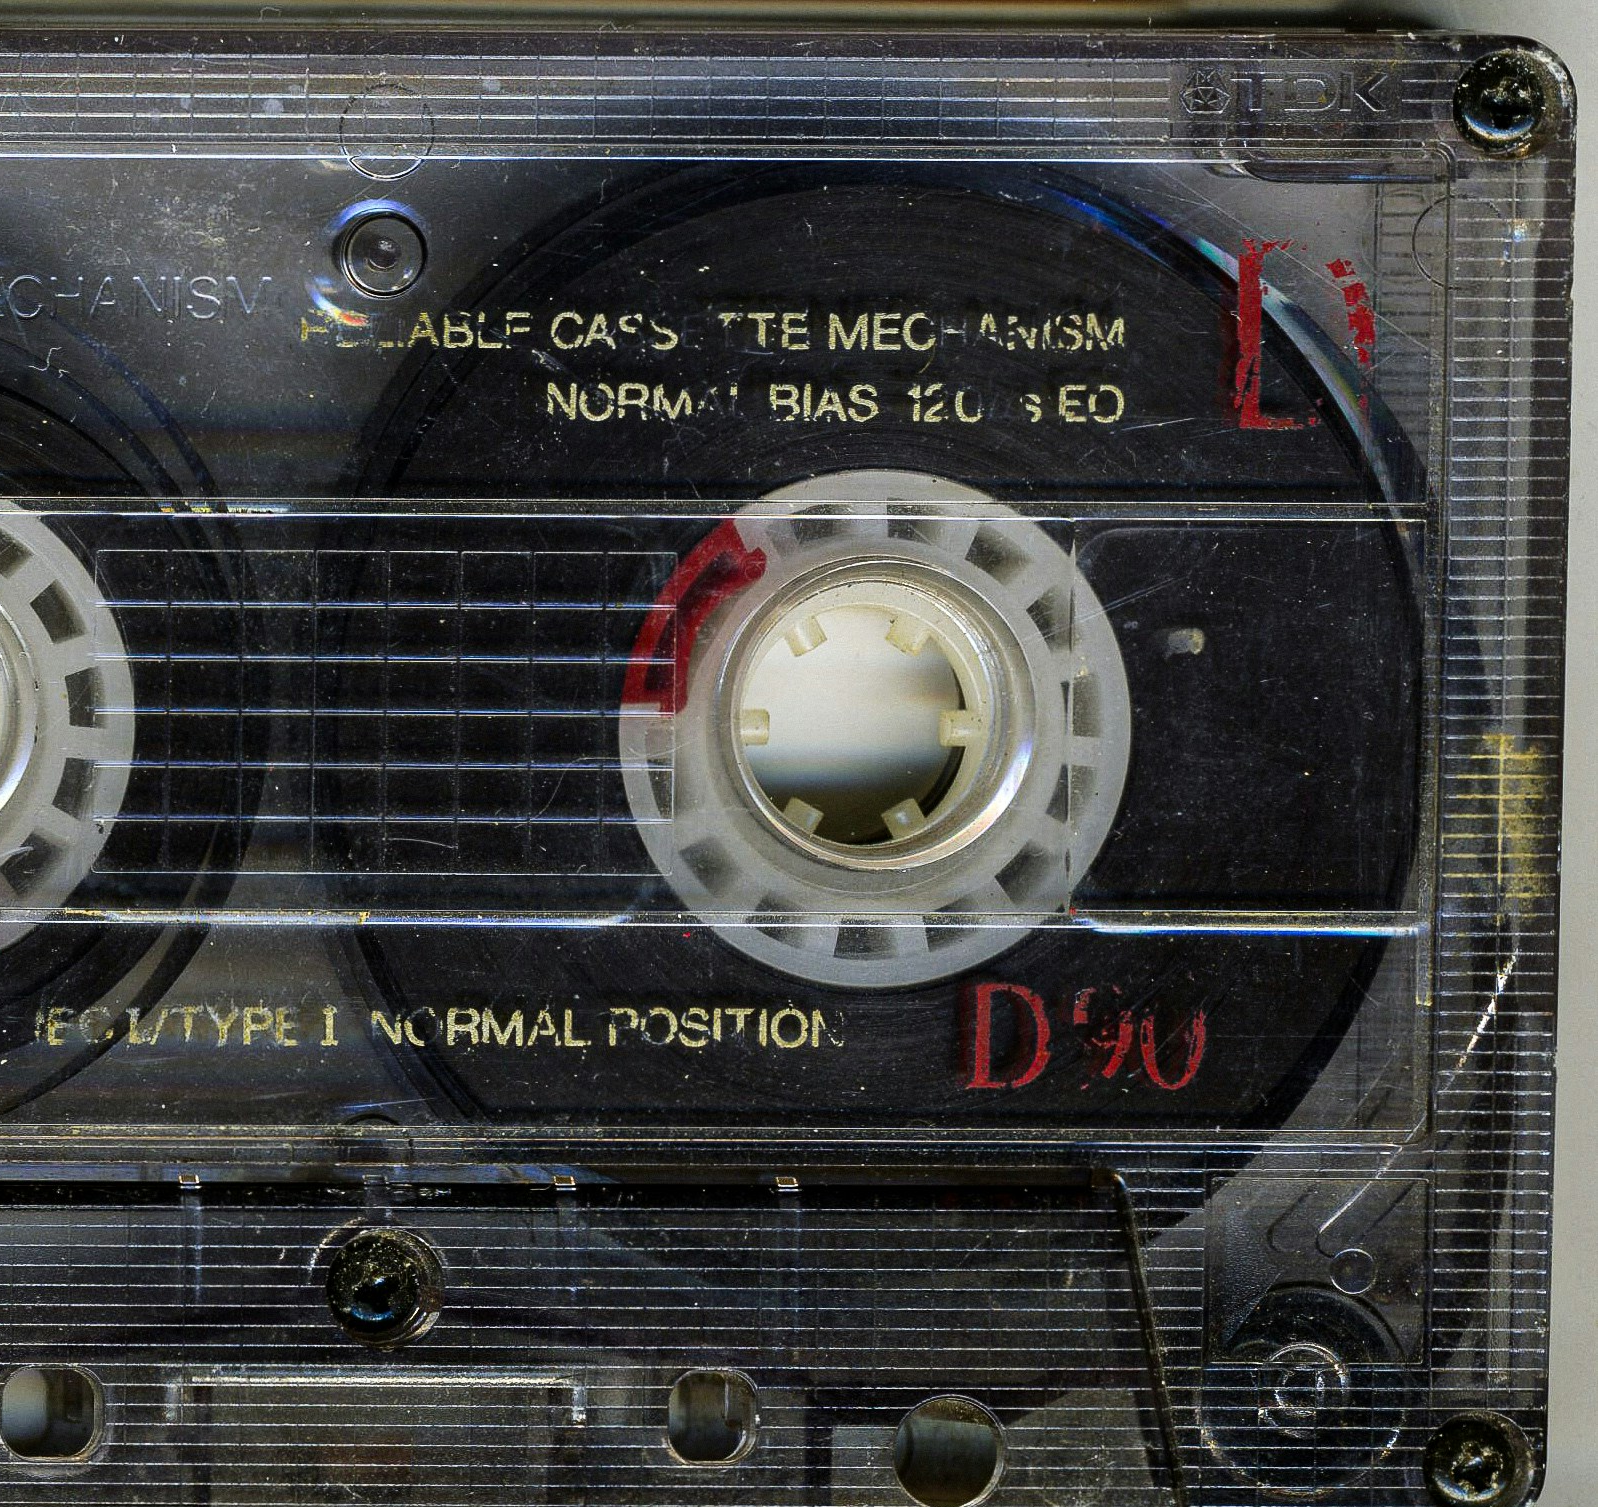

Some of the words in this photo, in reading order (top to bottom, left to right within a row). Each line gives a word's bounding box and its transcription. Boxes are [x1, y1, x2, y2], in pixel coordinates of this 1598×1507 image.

[771, 384, 878, 424] BIAS
[371, 1006, 591, 1048] NORMAL
[609, 1006, 845, 1050] POSITION
